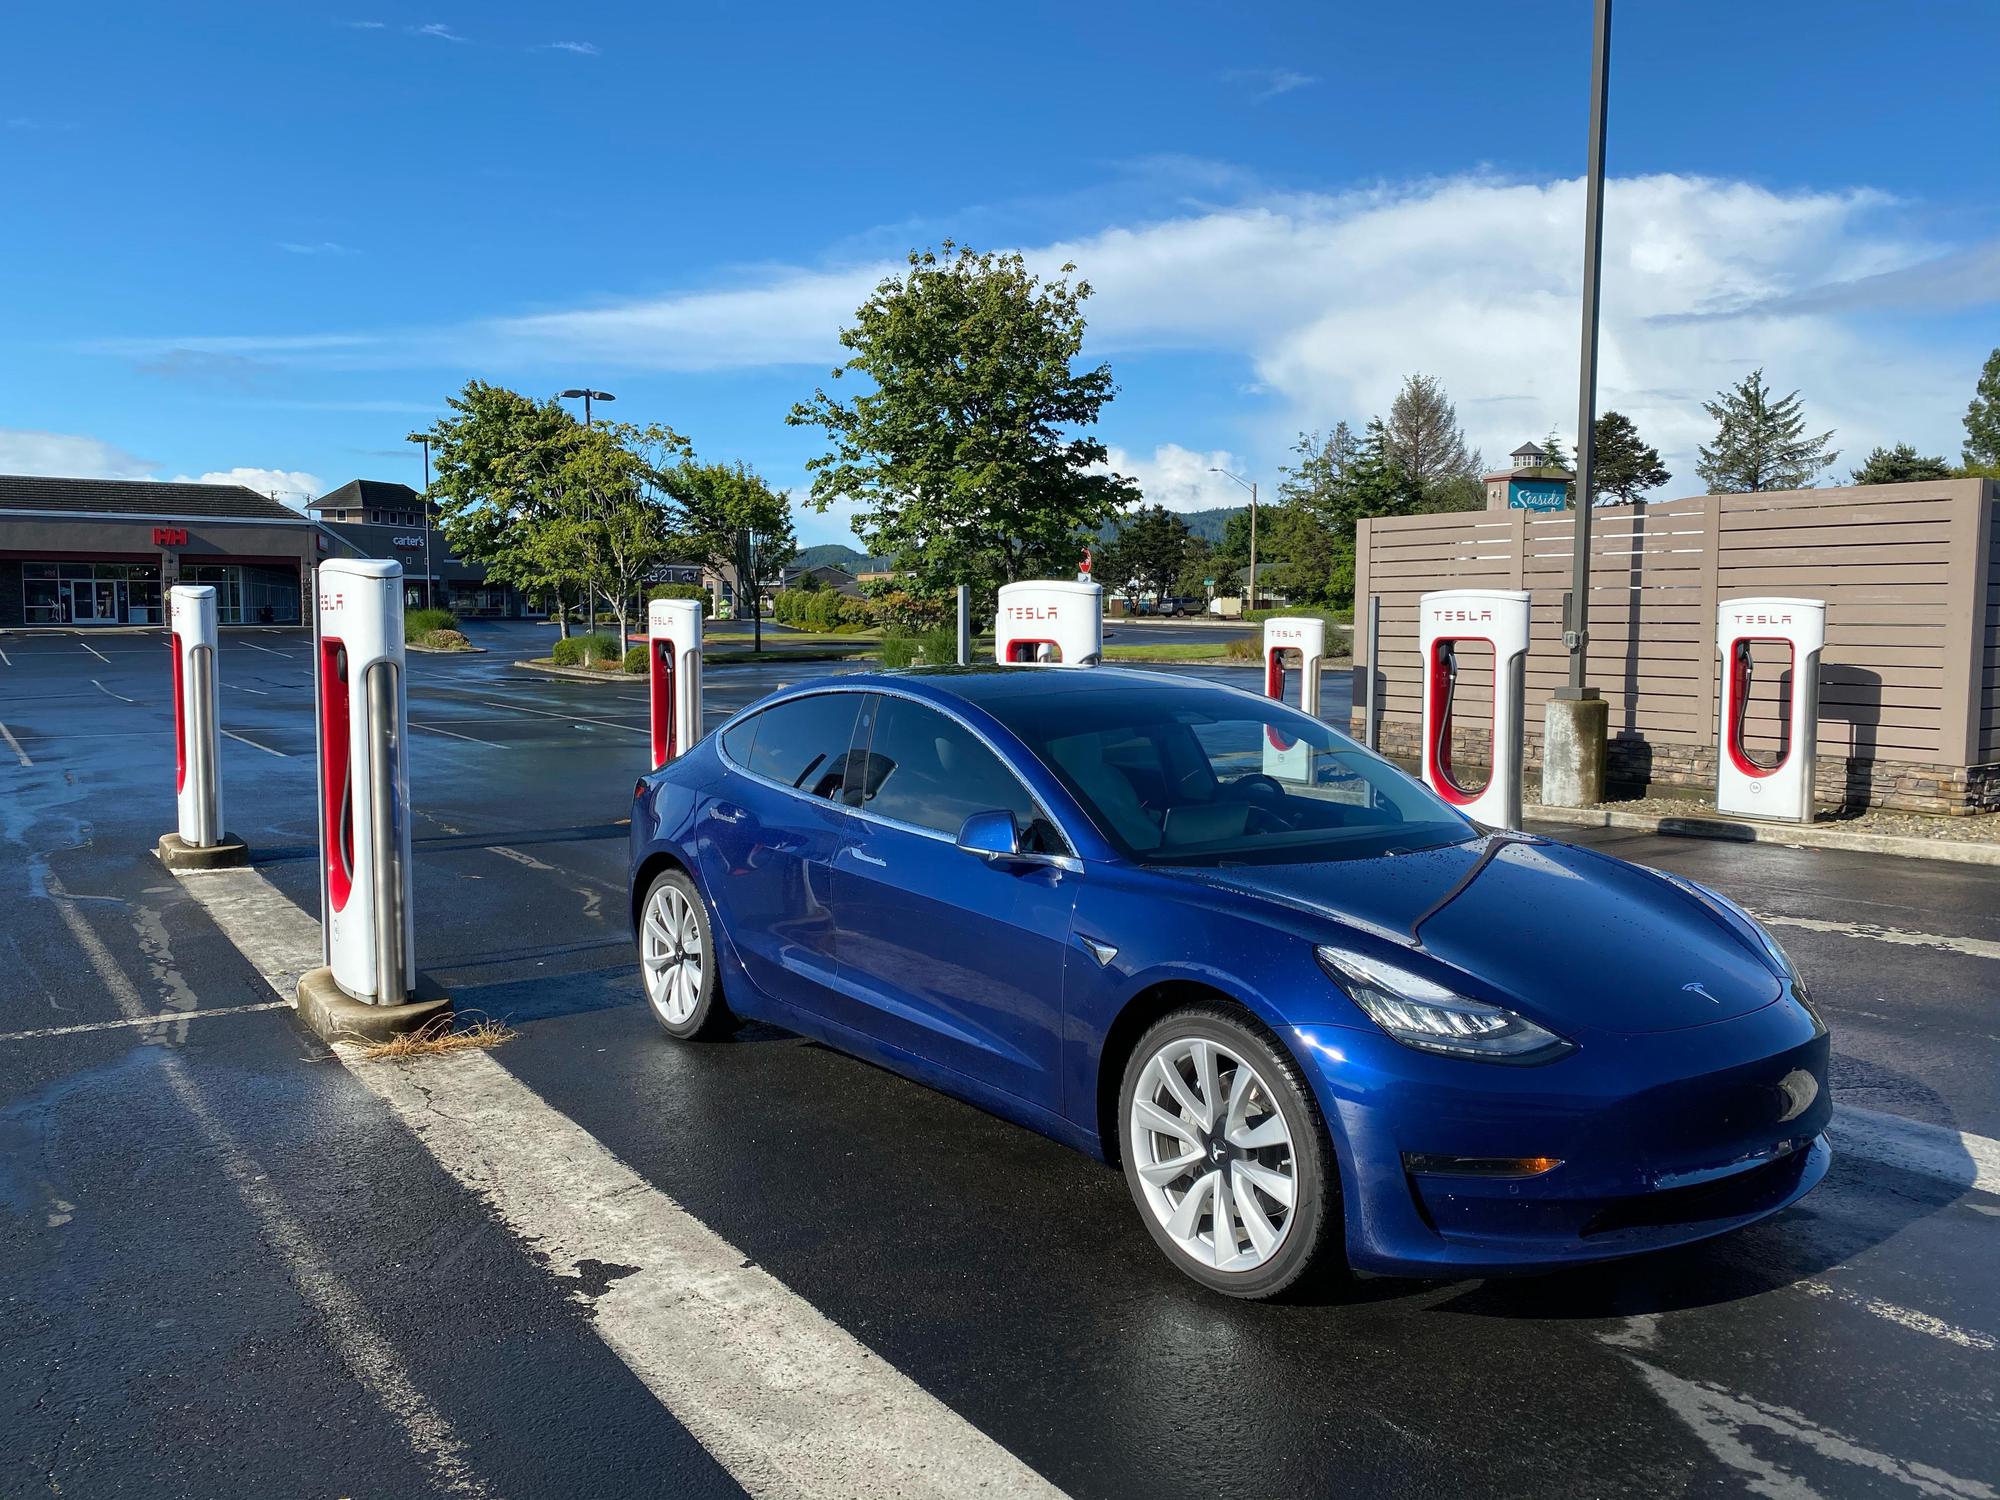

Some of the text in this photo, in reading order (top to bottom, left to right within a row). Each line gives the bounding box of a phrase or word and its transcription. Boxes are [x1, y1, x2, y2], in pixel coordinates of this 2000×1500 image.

[1510, 490, 1561, 509] Seaside
[392, 536, 425, 546] carter's
[1007, 607, 1057, 619] TESLA
[1434, 610, 1492, 621] TESLA
[650, 616, 673, 626] TESLA
[1734, 615, 1792, 624] TESLA
[1270, 630, 1302, 638] TESLA
